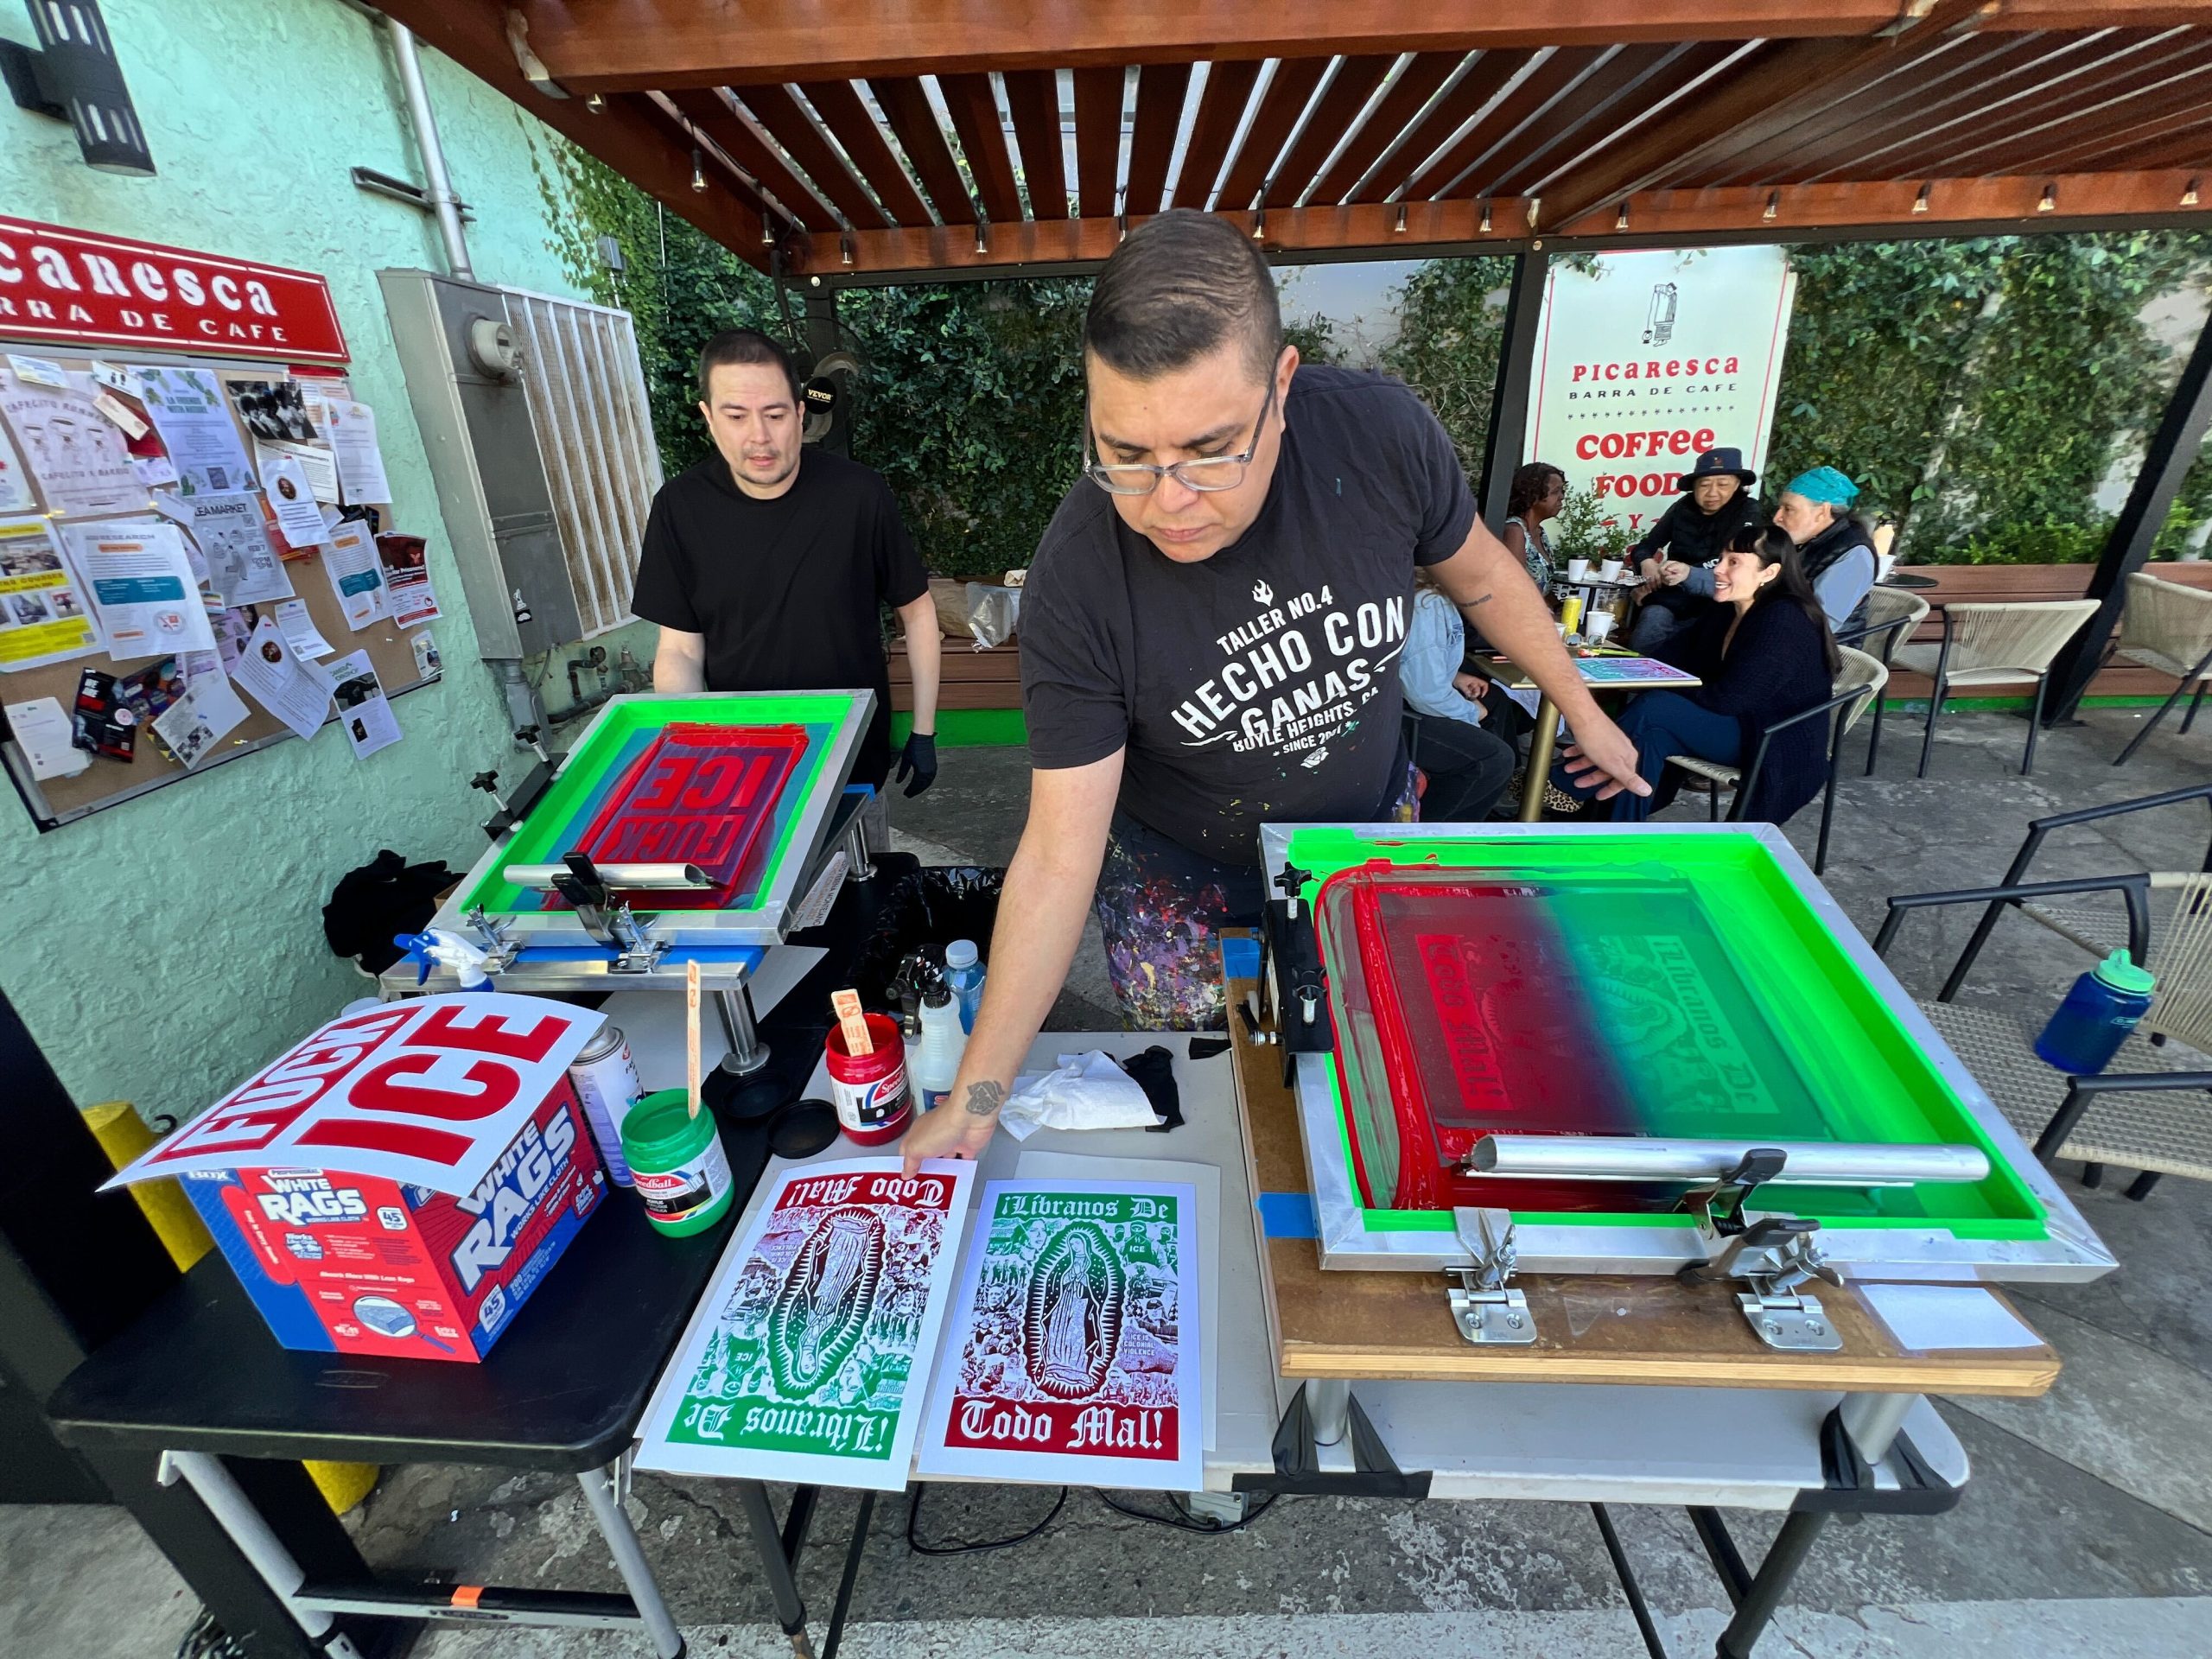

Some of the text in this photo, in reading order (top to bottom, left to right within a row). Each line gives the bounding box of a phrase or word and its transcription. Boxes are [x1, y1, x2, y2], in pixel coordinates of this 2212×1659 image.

[120, 309, 174, 331] DE
[199, 319, 289, 342] CAFE
[808, 389, 831, 401] VEVOR
[1569, 383, 1738, 400] BARRA DE CAFE
[1216, 584, 1333, 656] TALLER NO.4
[1170, 595, 1405, 739] HECHO CON
[1240, 658, 1372, 741] GANAS
[1282, 734, 1317, 754] SINCE
[631, 755, 775, 809] ICE
[607, 819, 735, 861] FUCK
[1427, 943, 1467, 1008] Todo
[169, 1007, 405, 1152] FUCK
[292, 1006, 573, 1166] ICE
[260, 1175, 332, 1194] WHITE
[455, 1119, 540, 1214] WHITE
[257, 1189, 367, 1226] RAGS
[453, 1106, 576, 1292] RAGS
[510, 1157, 570, 1240] WORKS LIKE CLOTH
[786, 1175, 945, 1207] Todo Mal!
[1129, 1197, 1168, 1219] De
[383, 1211, 402, 1224] 45
[484, 1295, 501, 1319] 45
[735, 1352, 753, 1362] ICE
[683, 1402, 737, 1441] De
[960, 1400, 1163, 1450] Todo Mal!
